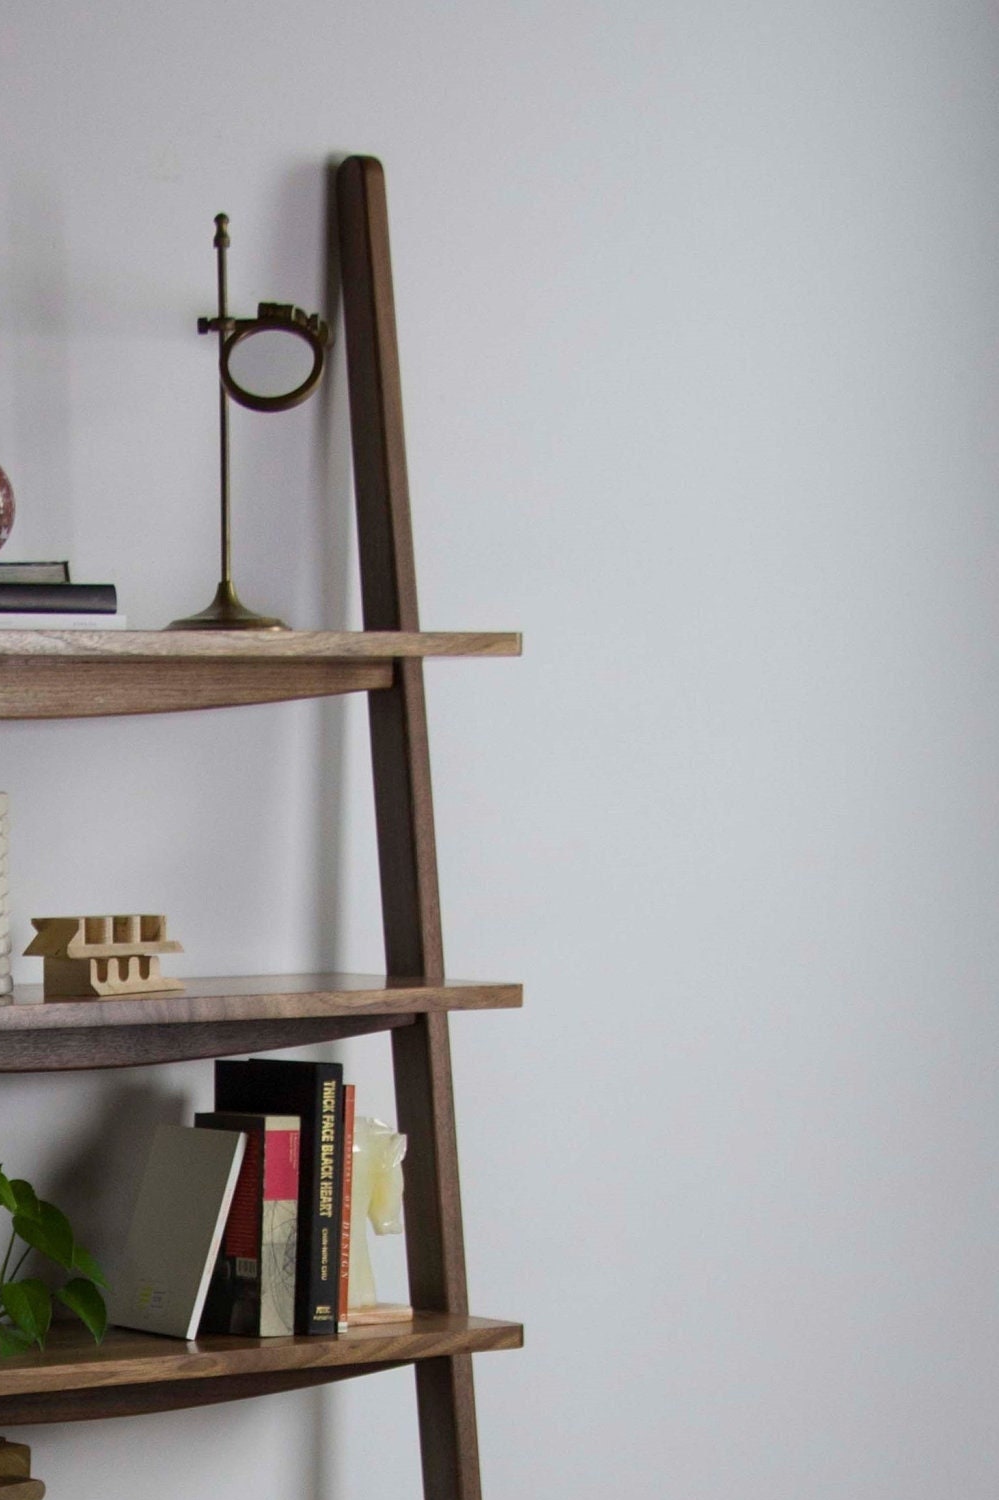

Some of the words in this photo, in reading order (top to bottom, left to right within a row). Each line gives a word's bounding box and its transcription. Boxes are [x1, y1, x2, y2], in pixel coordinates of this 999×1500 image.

[322, 1080, 337, 1113] THICK
[321, 1114, 335, 1142] FACE
[320, 1144, 334, 1180] BLACK
[319, 1181, 333, 1217] HEART
[341, 1221, 350, 1279] DESIGN
